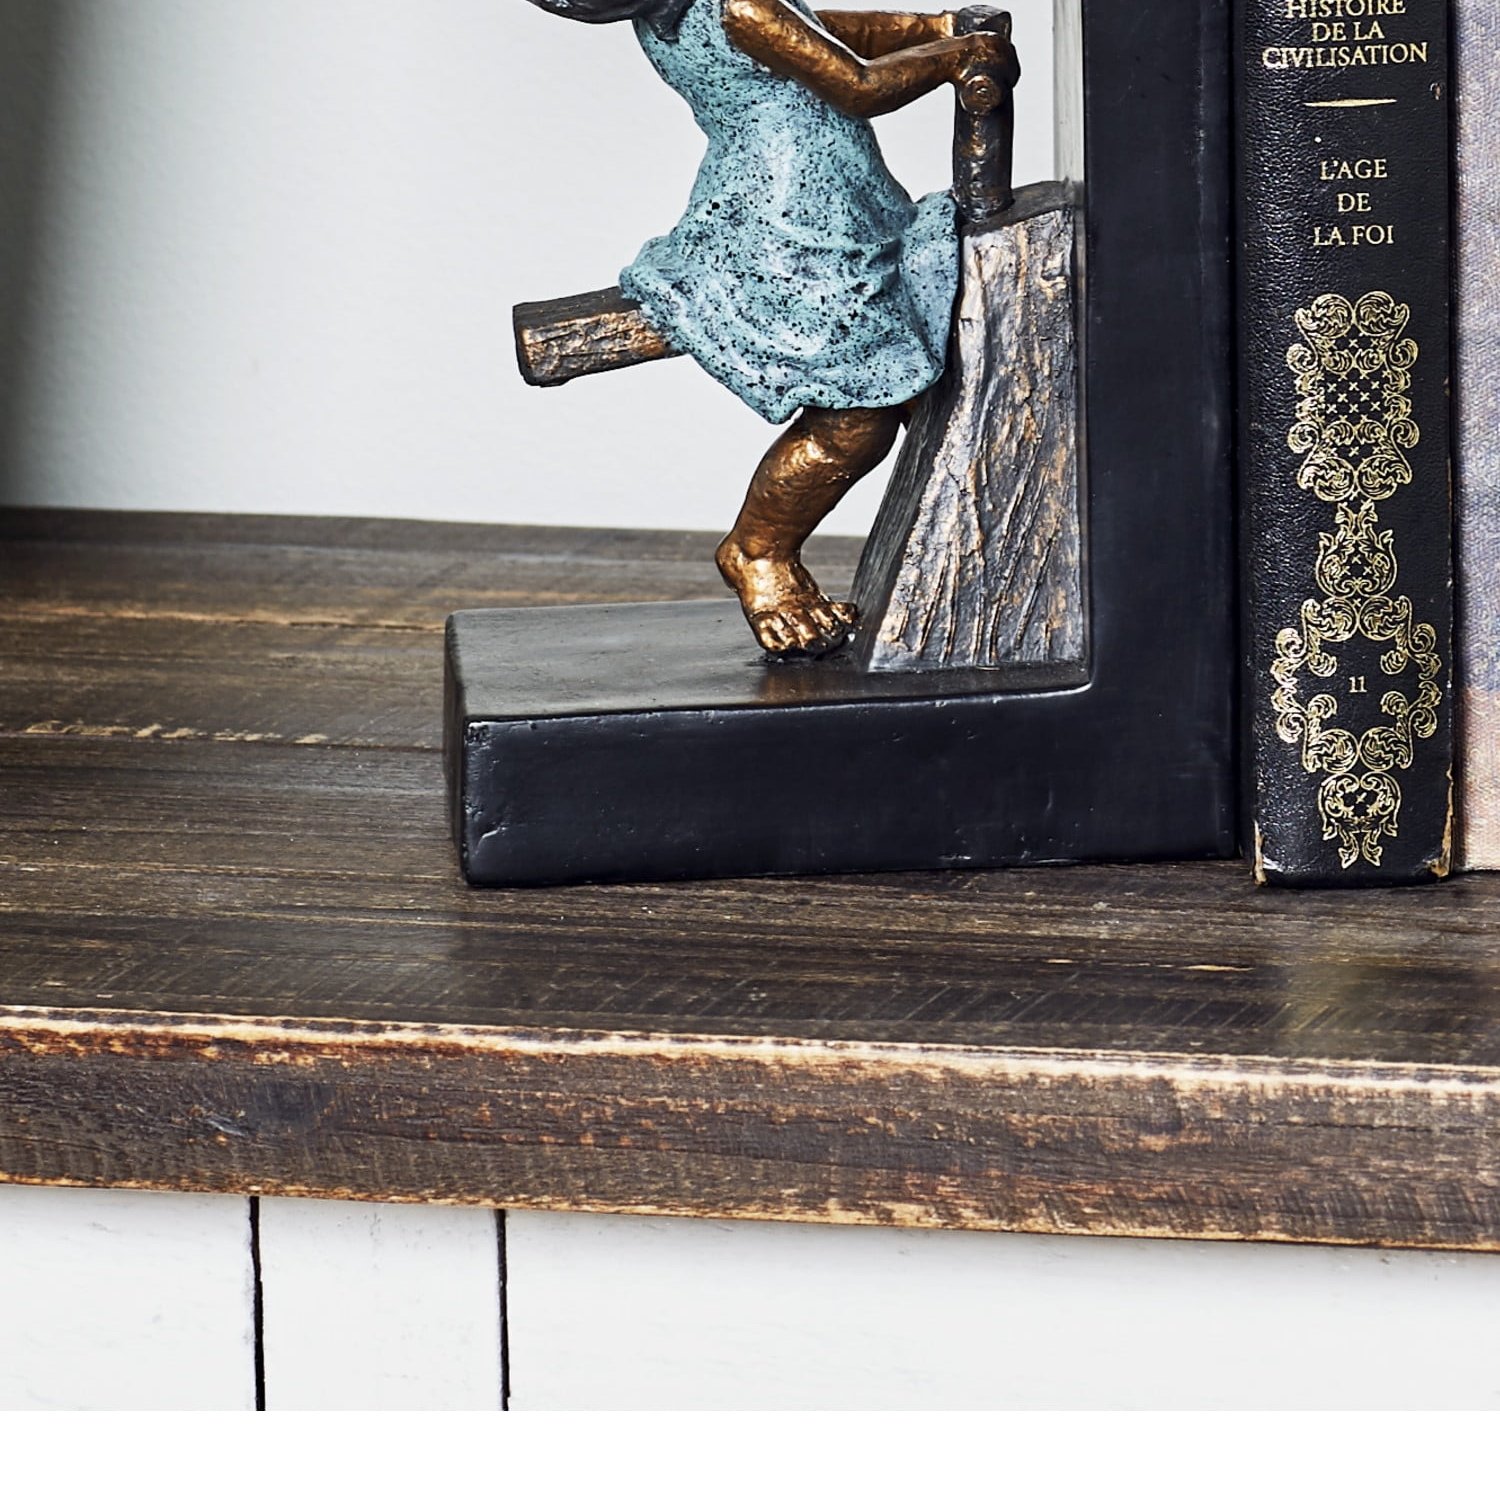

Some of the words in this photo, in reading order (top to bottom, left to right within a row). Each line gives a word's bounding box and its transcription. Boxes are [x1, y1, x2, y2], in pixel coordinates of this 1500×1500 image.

[1311, 22, 1346, 42] DE
[1353, 20, 1385, 41] LA
[1261, 42, 1428, 68] CIVILISATION
[1319, 158, 1388, 181] L'AGE
[1336, 192, 1372, 212] DE
[1313, 226, 1346, 246] LA
[1352, 225, 1394, 245] FOI
[1348, 676, 1368, 693] 11
